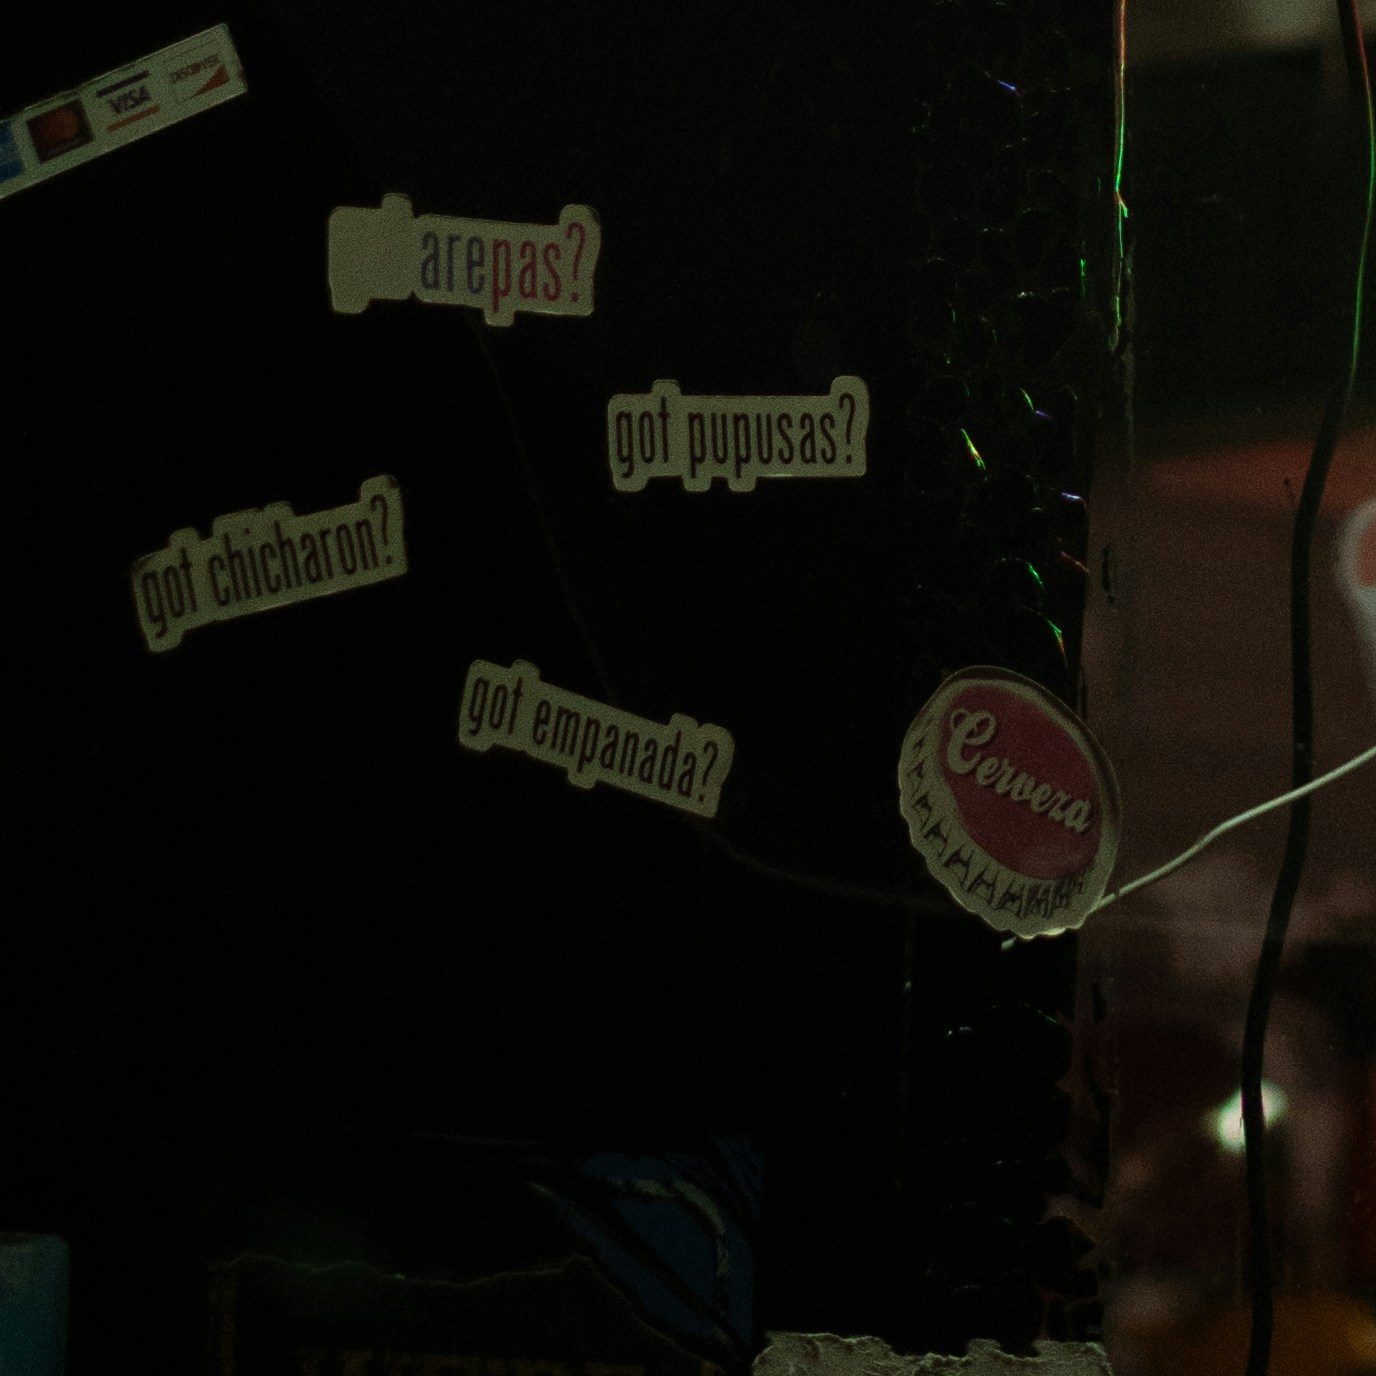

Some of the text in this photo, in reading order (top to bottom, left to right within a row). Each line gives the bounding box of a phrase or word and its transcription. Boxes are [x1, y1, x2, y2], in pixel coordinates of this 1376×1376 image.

[108, 86, 150, 114] VISA
[419, 221, 587, 315] arepas?
[614, 392, 858, 479] got pupusas?
[138, 494, 396, 641] got chicharon?
[466, 673, 722, 804] got empanada?
[946, 707, 1094, 833] Cerveza
